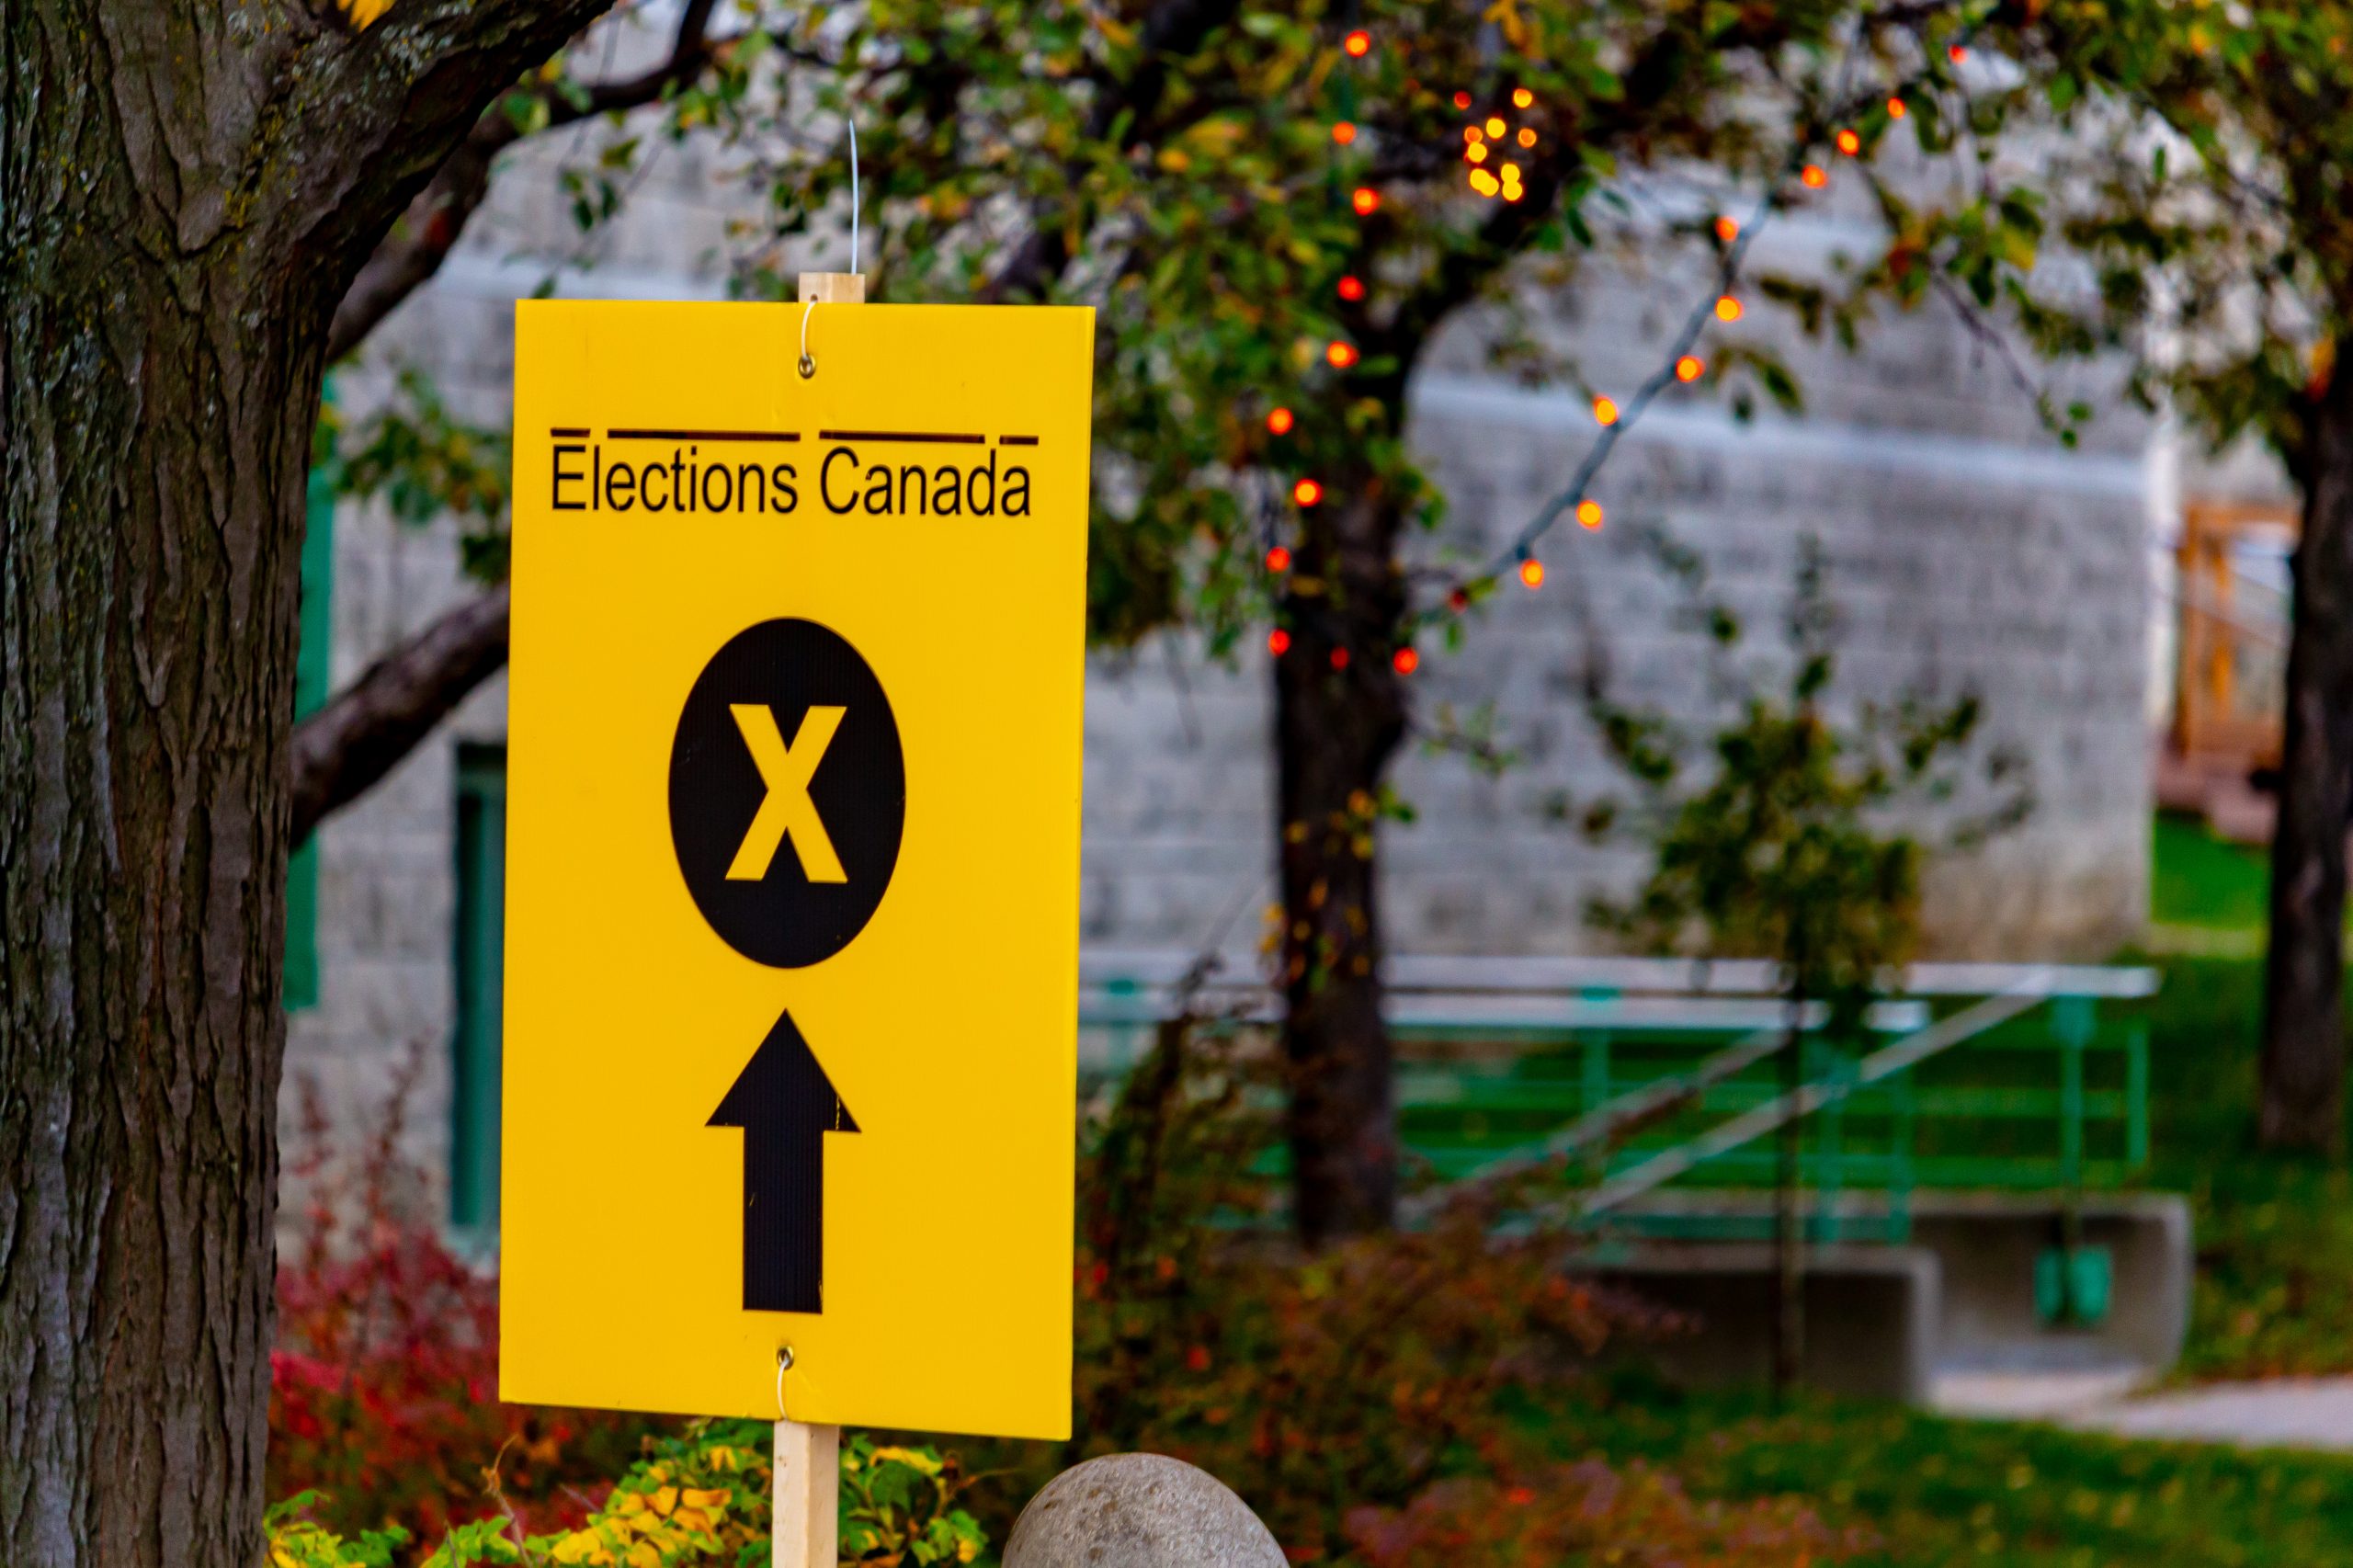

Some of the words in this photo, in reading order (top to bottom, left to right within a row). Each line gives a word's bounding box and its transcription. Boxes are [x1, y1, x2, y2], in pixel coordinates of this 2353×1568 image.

[551, 445, 799, 514] Elections
[819, 447, 1031, 517] Canada
[724, 703, 848, 884] X
